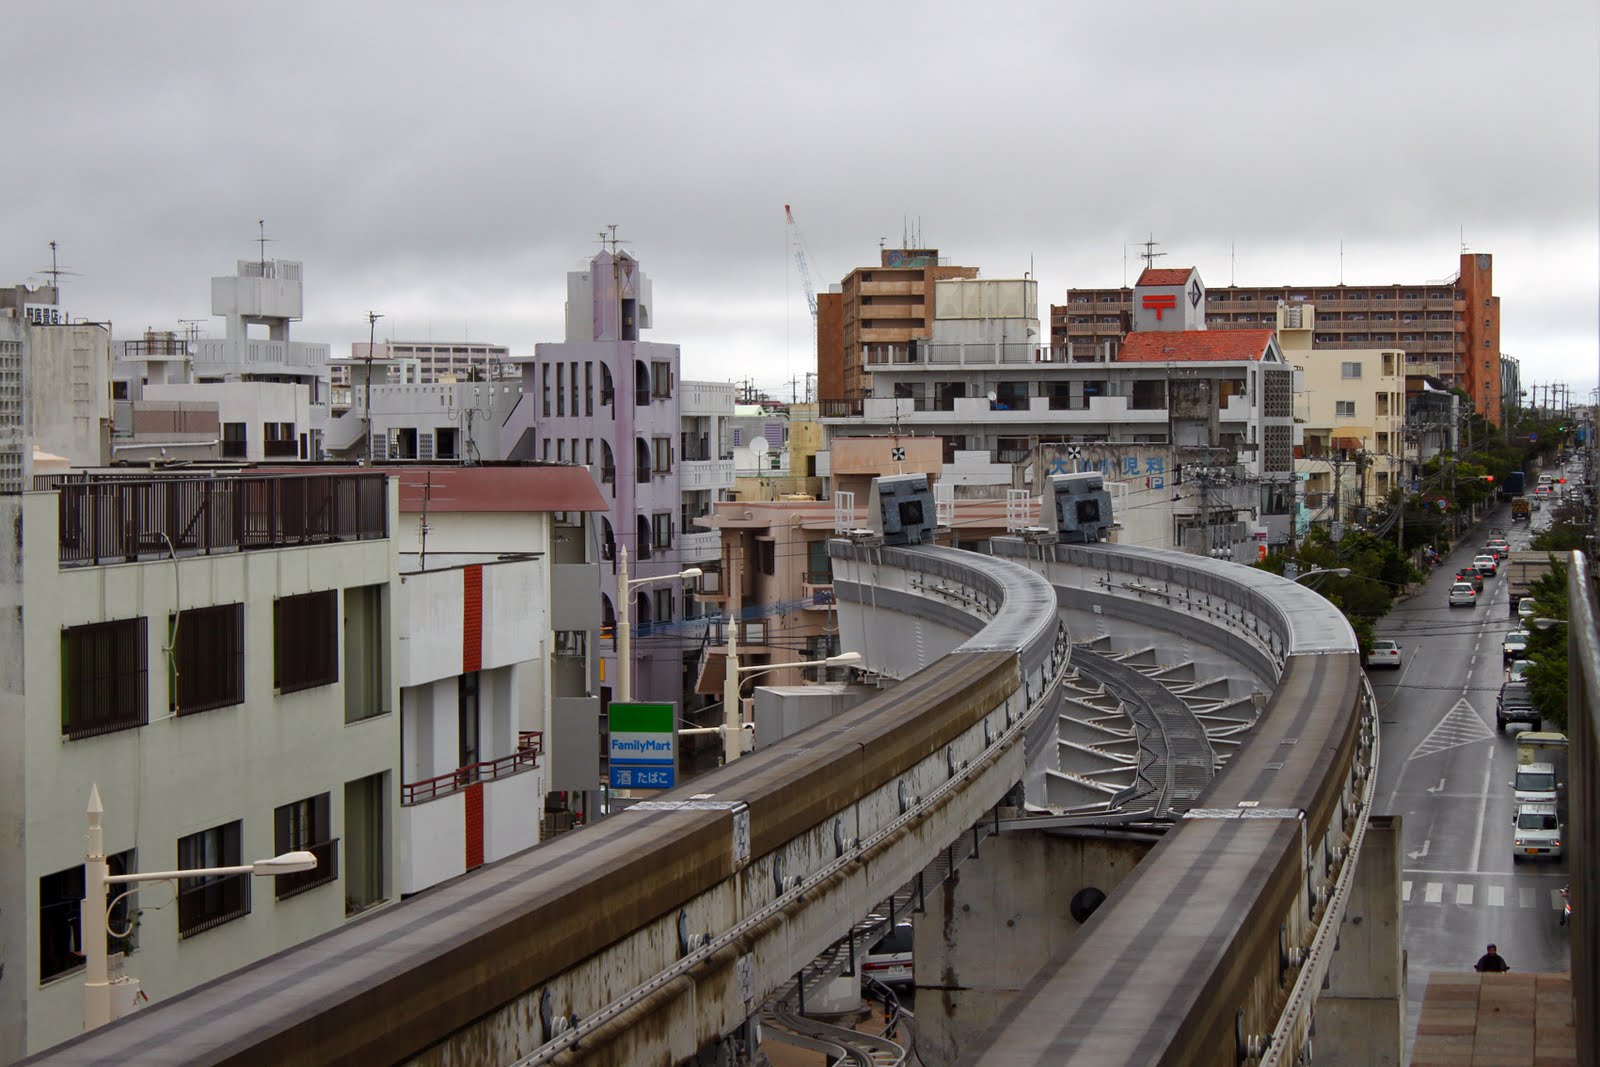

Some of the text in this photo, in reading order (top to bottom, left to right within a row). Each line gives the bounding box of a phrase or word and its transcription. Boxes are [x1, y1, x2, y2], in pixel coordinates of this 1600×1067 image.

[611, 739, 671, 753] FamilyMart
[617, 770, 668, 785] 酒 たばこ
